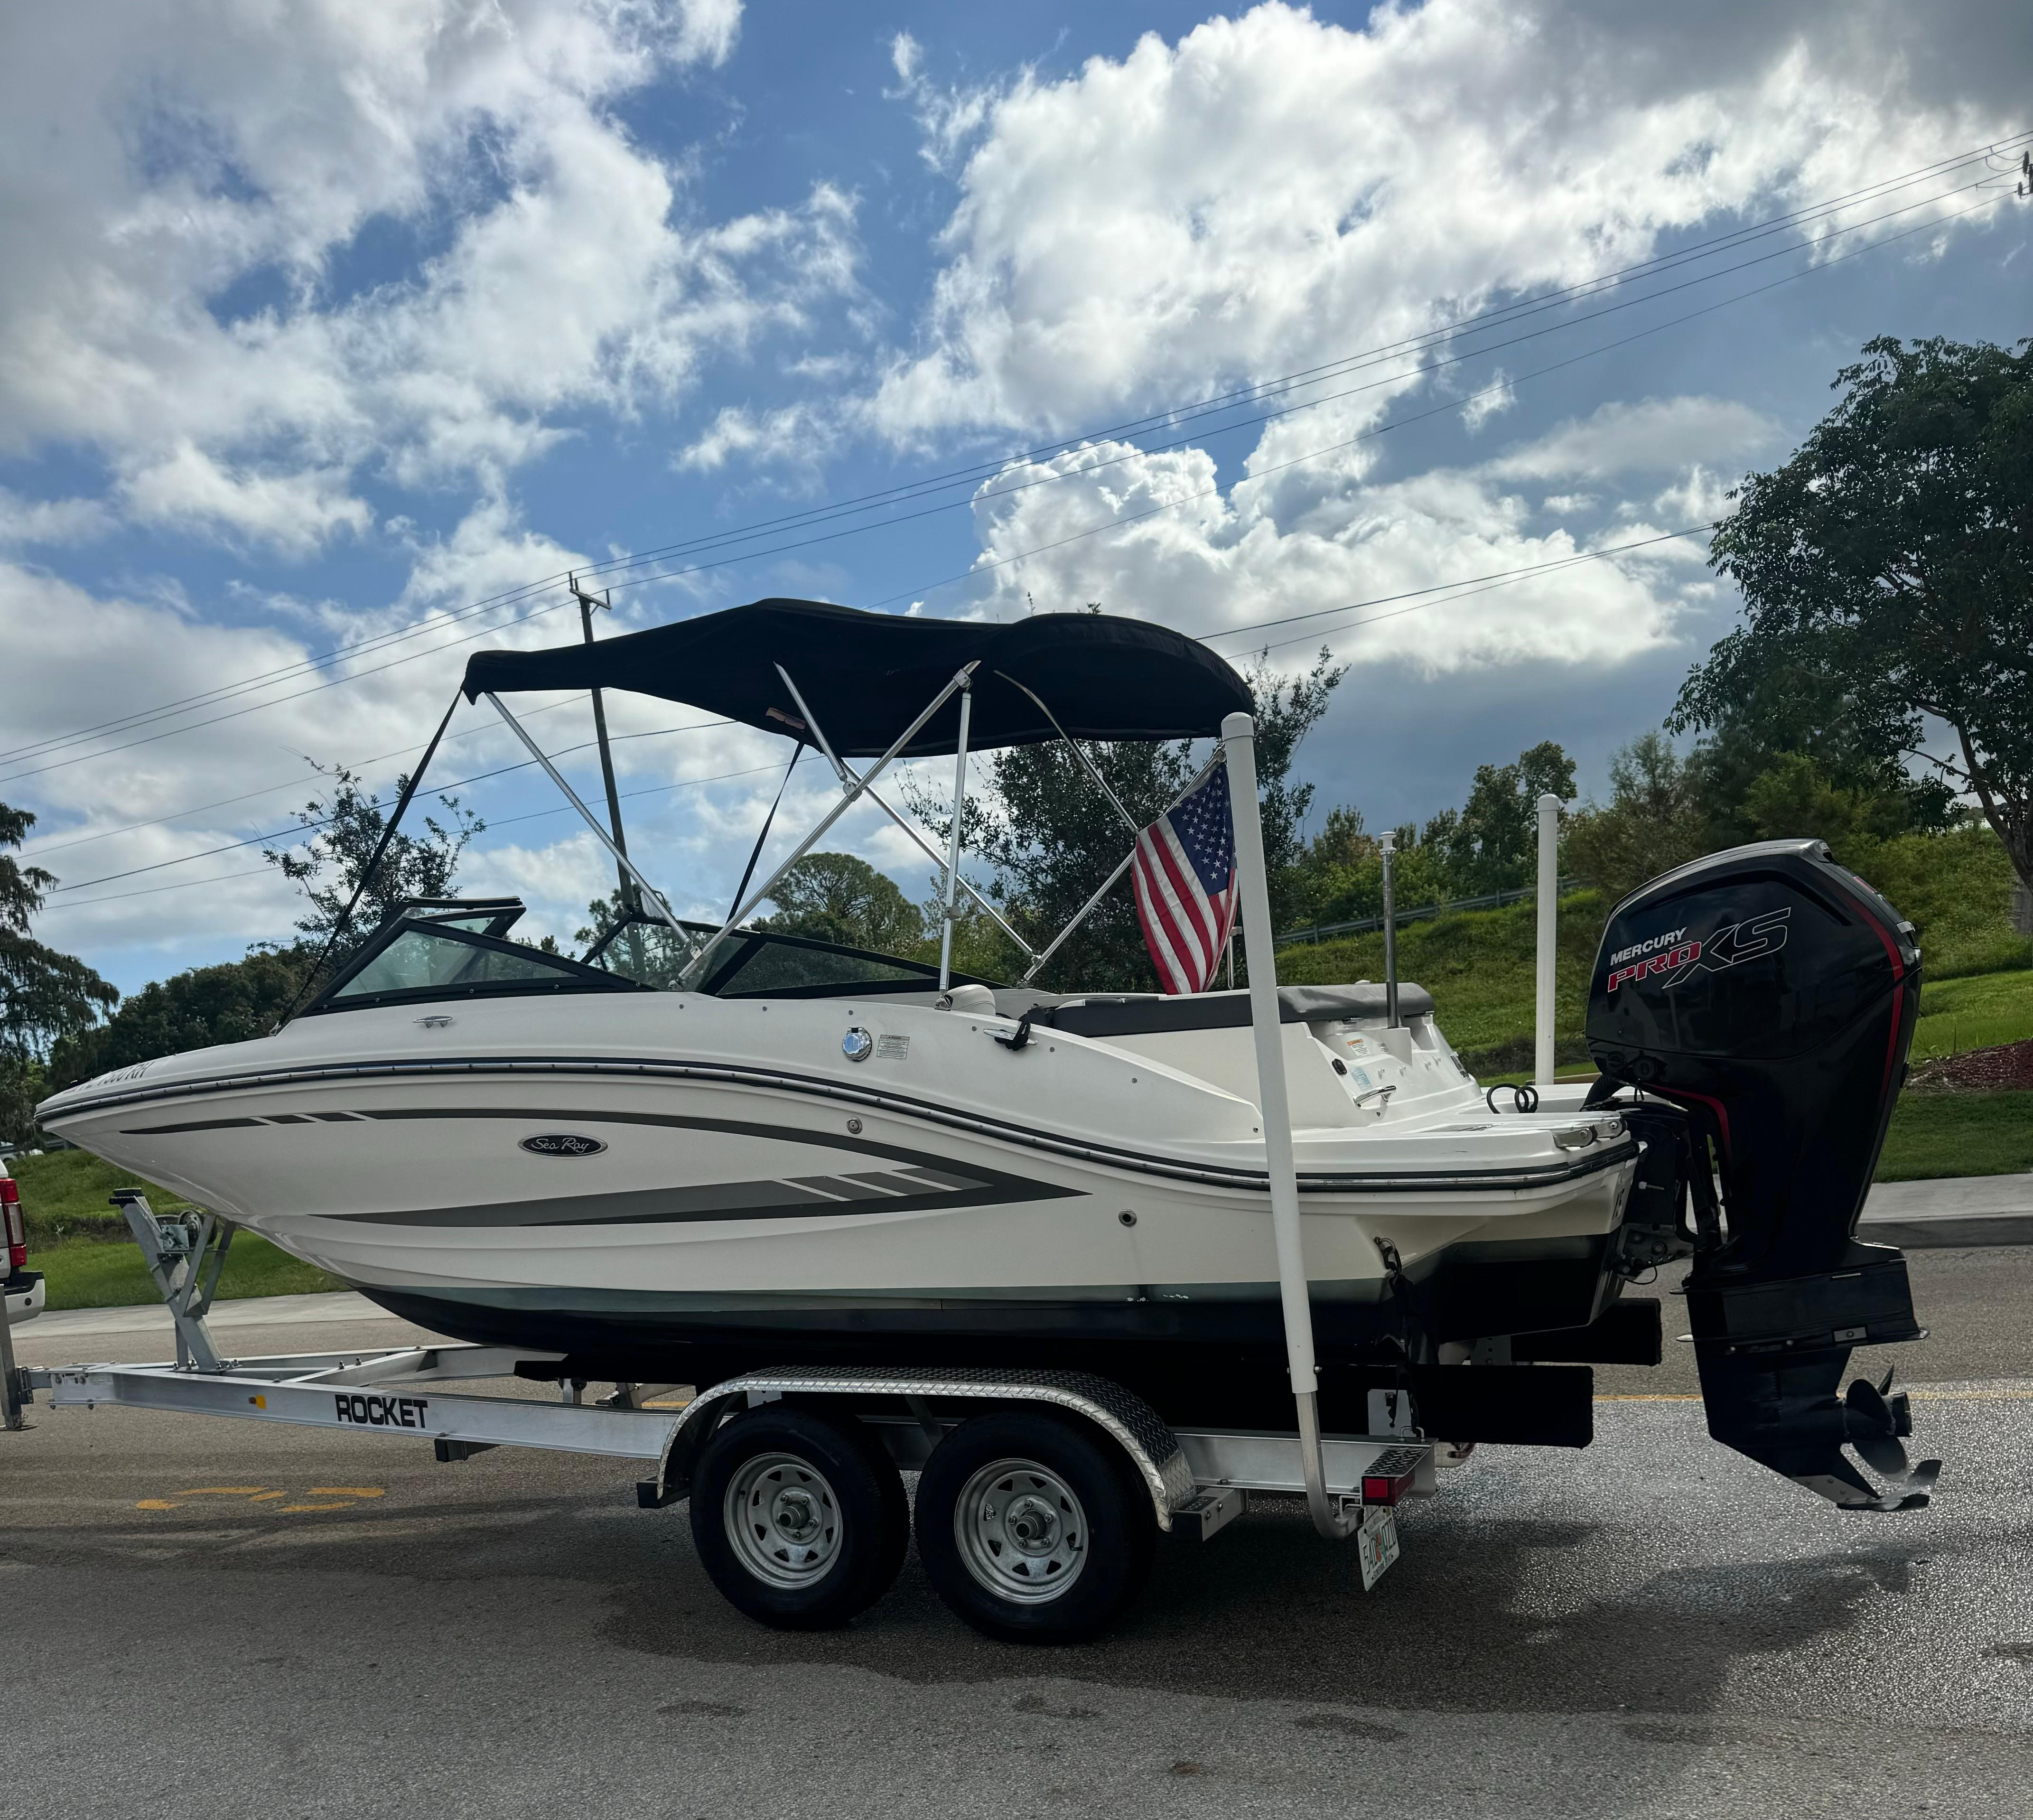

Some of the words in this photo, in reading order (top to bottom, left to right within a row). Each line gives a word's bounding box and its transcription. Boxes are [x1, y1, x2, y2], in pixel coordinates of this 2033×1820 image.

[1607, 941, 1702, 993] PRO
[1662, 906, 1791, 989] XS
[1610, 927, 1688, 966] MERCURY
[531, 1138, 559, 1149] Sea
[561, 1137, 590, 1153] Ray
[335, 1394, 428, 1428] ROCKET
